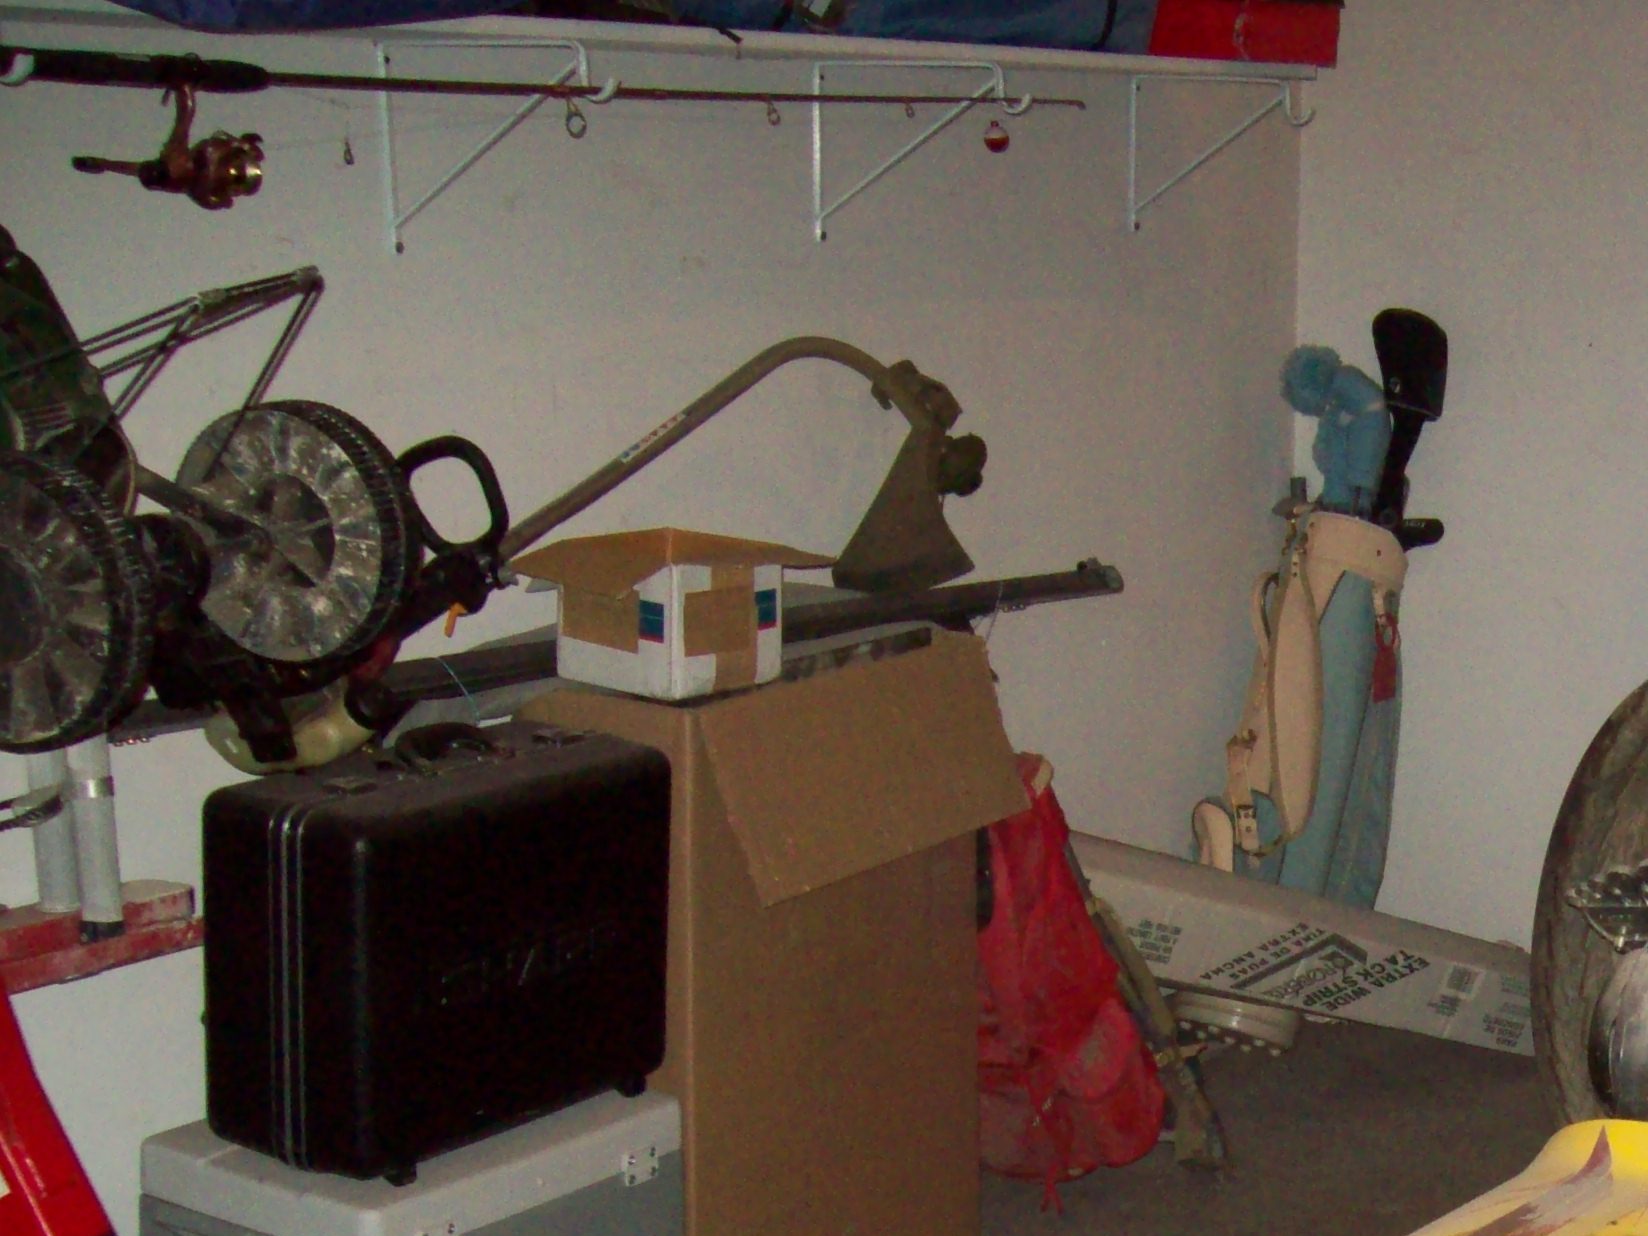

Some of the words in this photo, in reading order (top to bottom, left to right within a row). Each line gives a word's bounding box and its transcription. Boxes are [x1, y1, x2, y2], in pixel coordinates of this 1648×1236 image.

[1356, 949, 1414, 981] TACK
[1371, 956, 1430, 989] EXTRA
[1303, 975, 1358, 1008] STRIP
[1323, 985, 1372, 1012] WIDE
